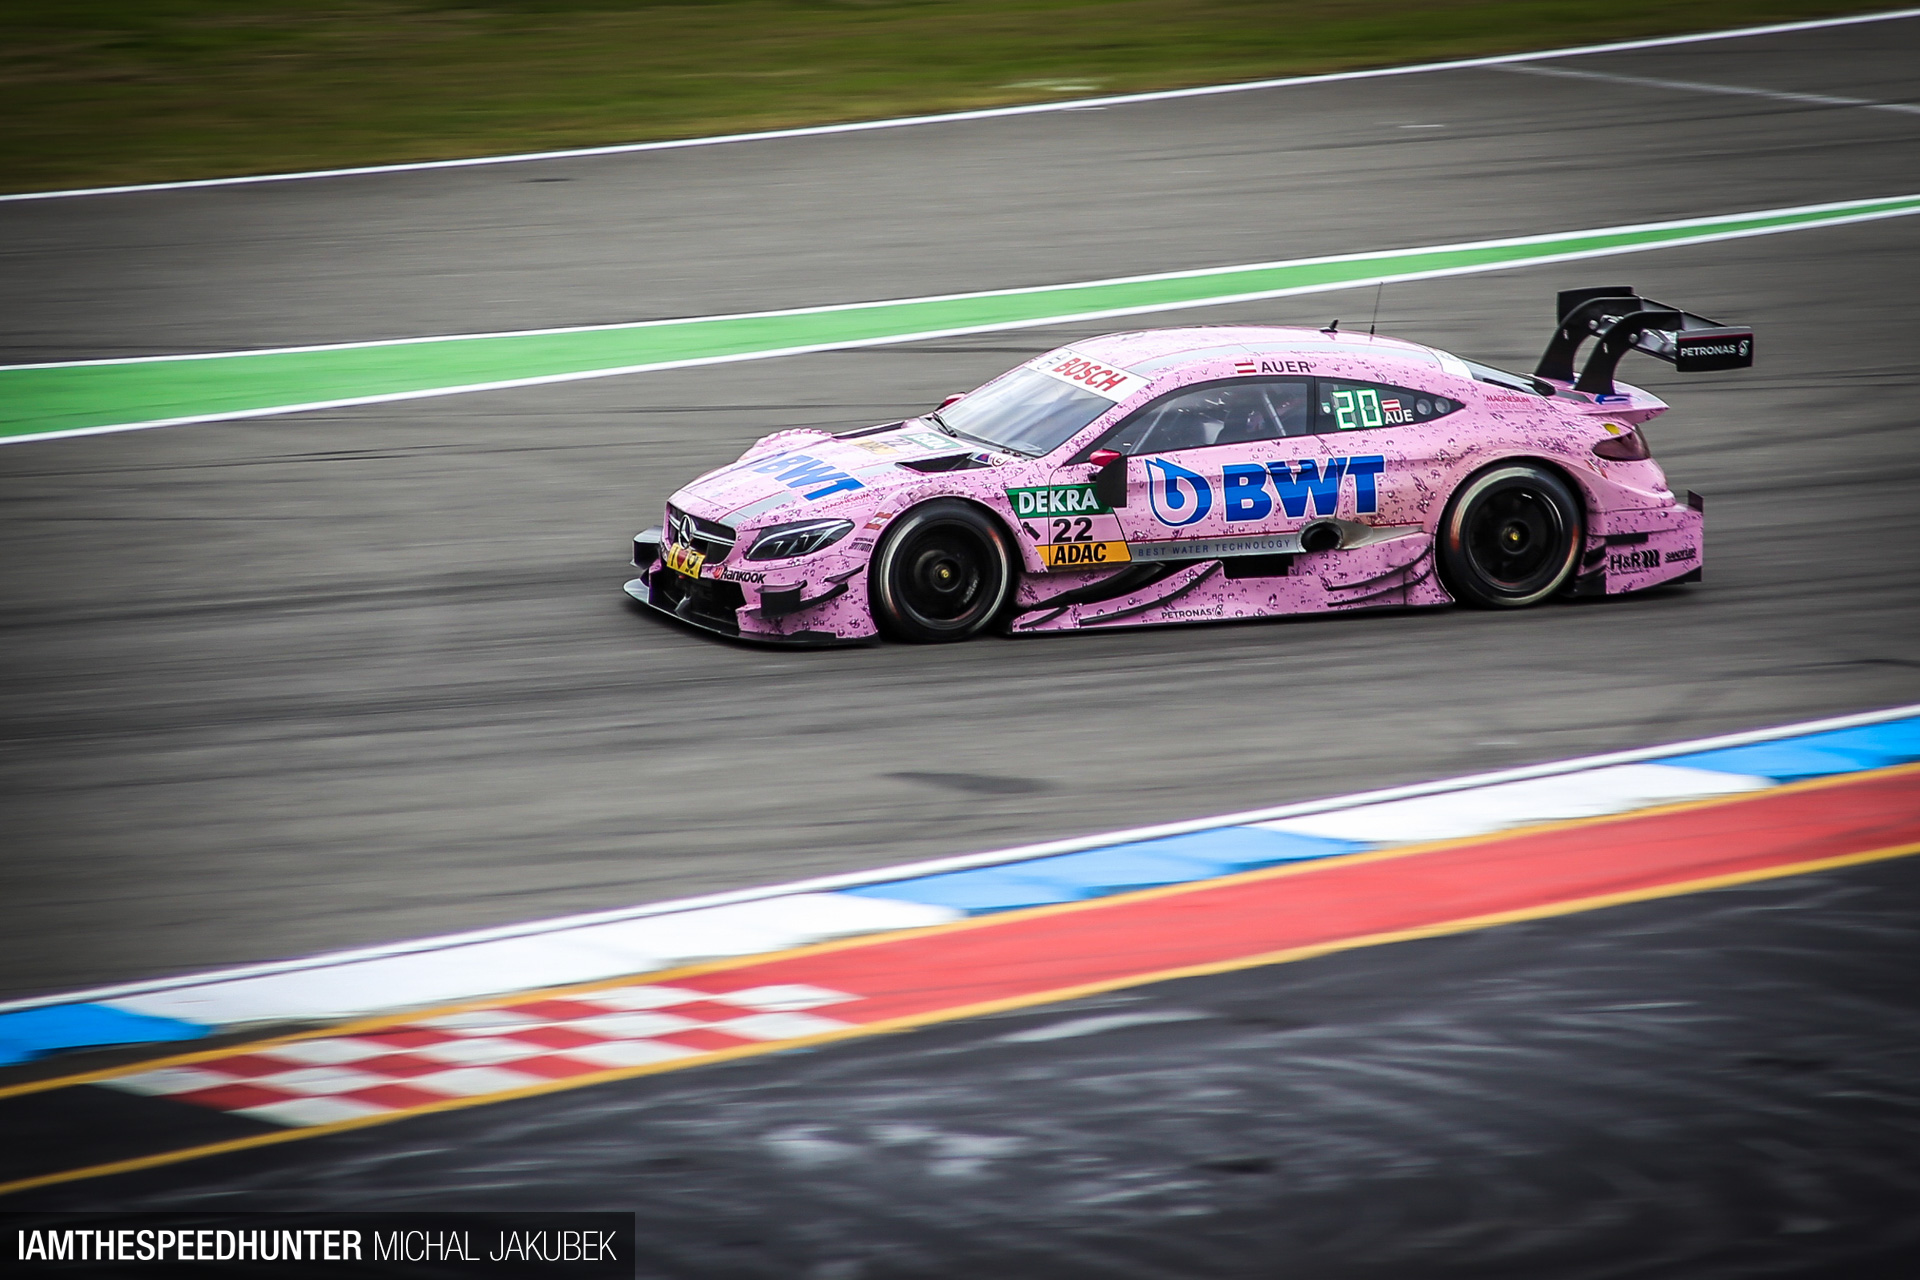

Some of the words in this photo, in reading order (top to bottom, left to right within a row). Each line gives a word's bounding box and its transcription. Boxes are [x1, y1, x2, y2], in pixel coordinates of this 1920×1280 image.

[1680, 345, 1737, 358] PETRONAS
[1052, 357, 1128, 392] BOSCH
[1261, 361, 1312, 373] AUER
[1332, 389, 1384, 430] 20
[1384, 409, 1414, 425] AUE
[752, 454, 866, 501] BWT
[1222, 455, 1385, 523] BWT
[1018, 488, 1100, 514] DEKRA
[1052, 517, 1094, 544] 22
[1054, 543, 1107, 565] ADAC
[1138, 547, 1166, 557] BEST
[1172, 544, 1209, 554] WATER
[1215, 539, 1291, 552] TECHNOLOGY
[1610, 552, 1641, 570] H&R
[1161, 609, 1213, 619] PETRONAS
